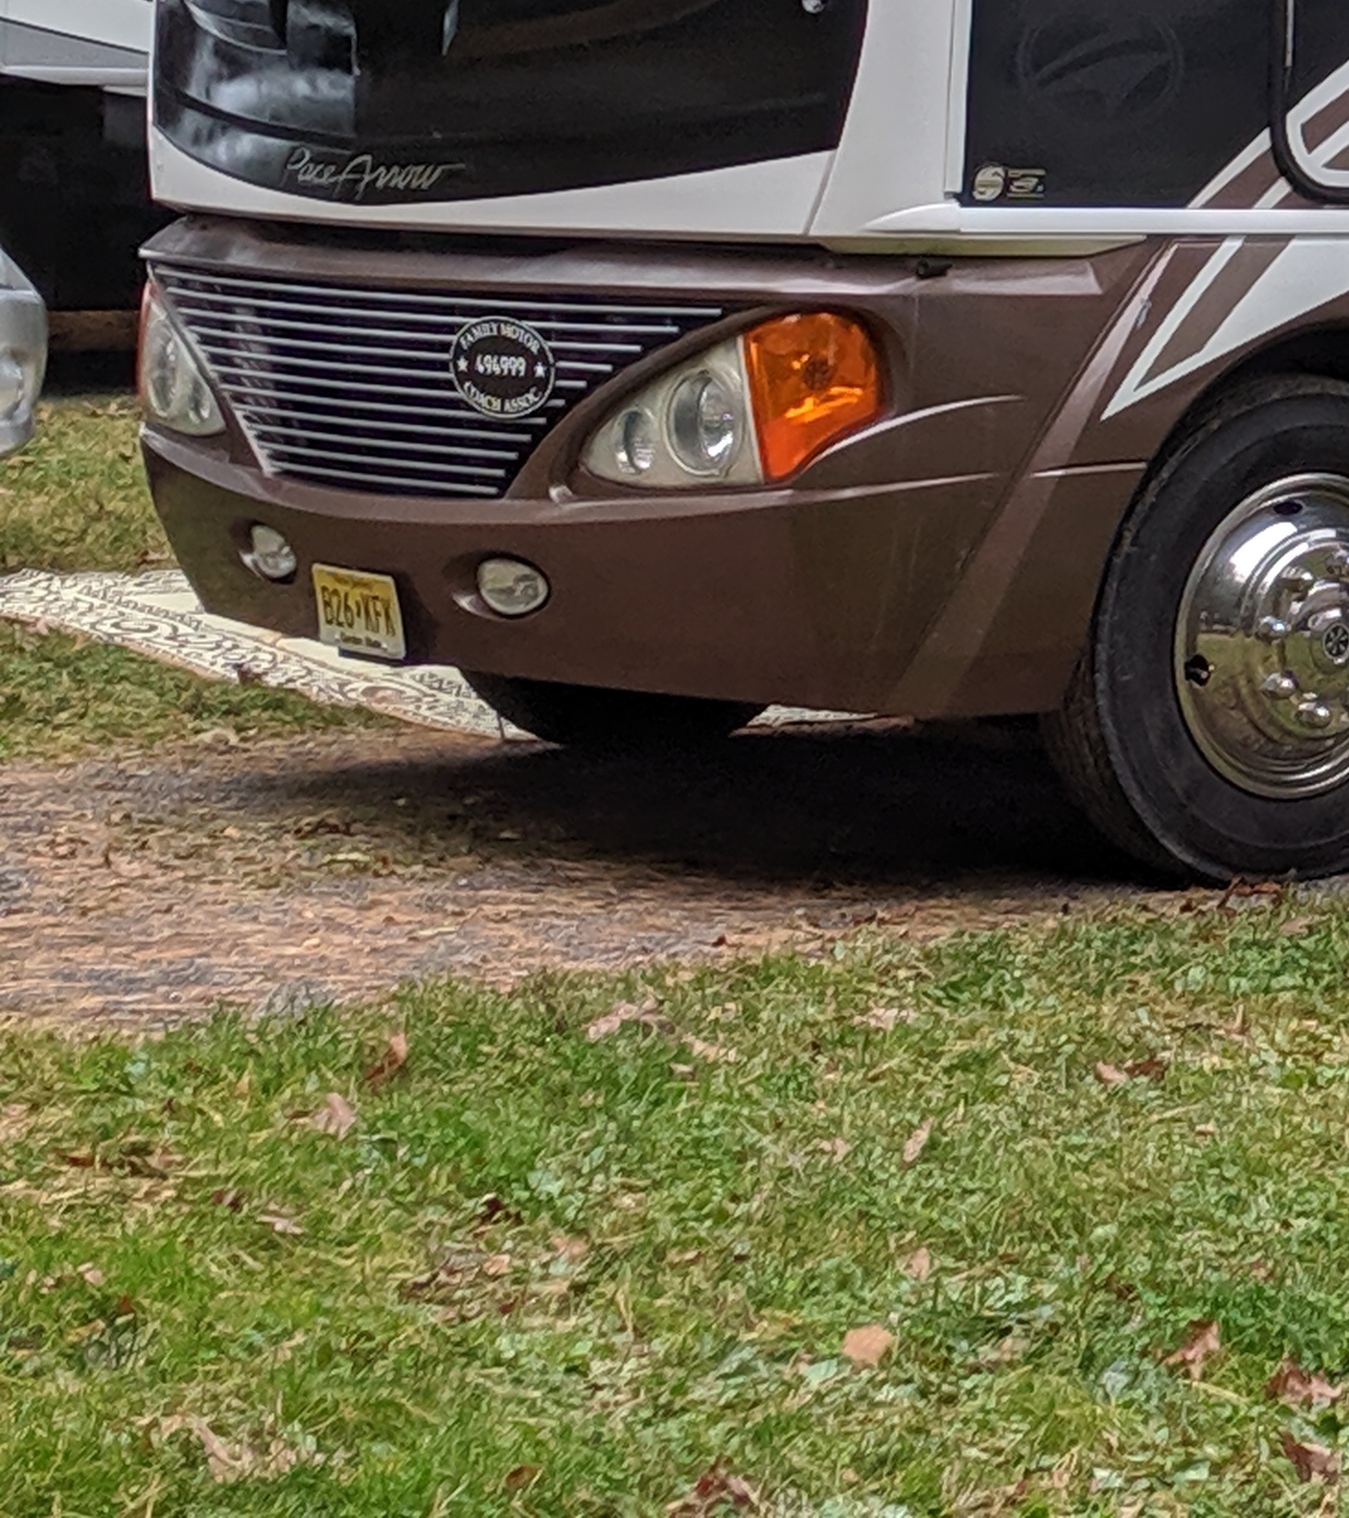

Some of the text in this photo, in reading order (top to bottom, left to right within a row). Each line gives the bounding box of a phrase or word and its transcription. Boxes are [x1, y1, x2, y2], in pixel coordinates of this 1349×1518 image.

[280, 147, 466, 200] Pace Arrow
[460, 322, 541, 355] FAMILY MOTOR
[463, 381, 502, 412] COACH
